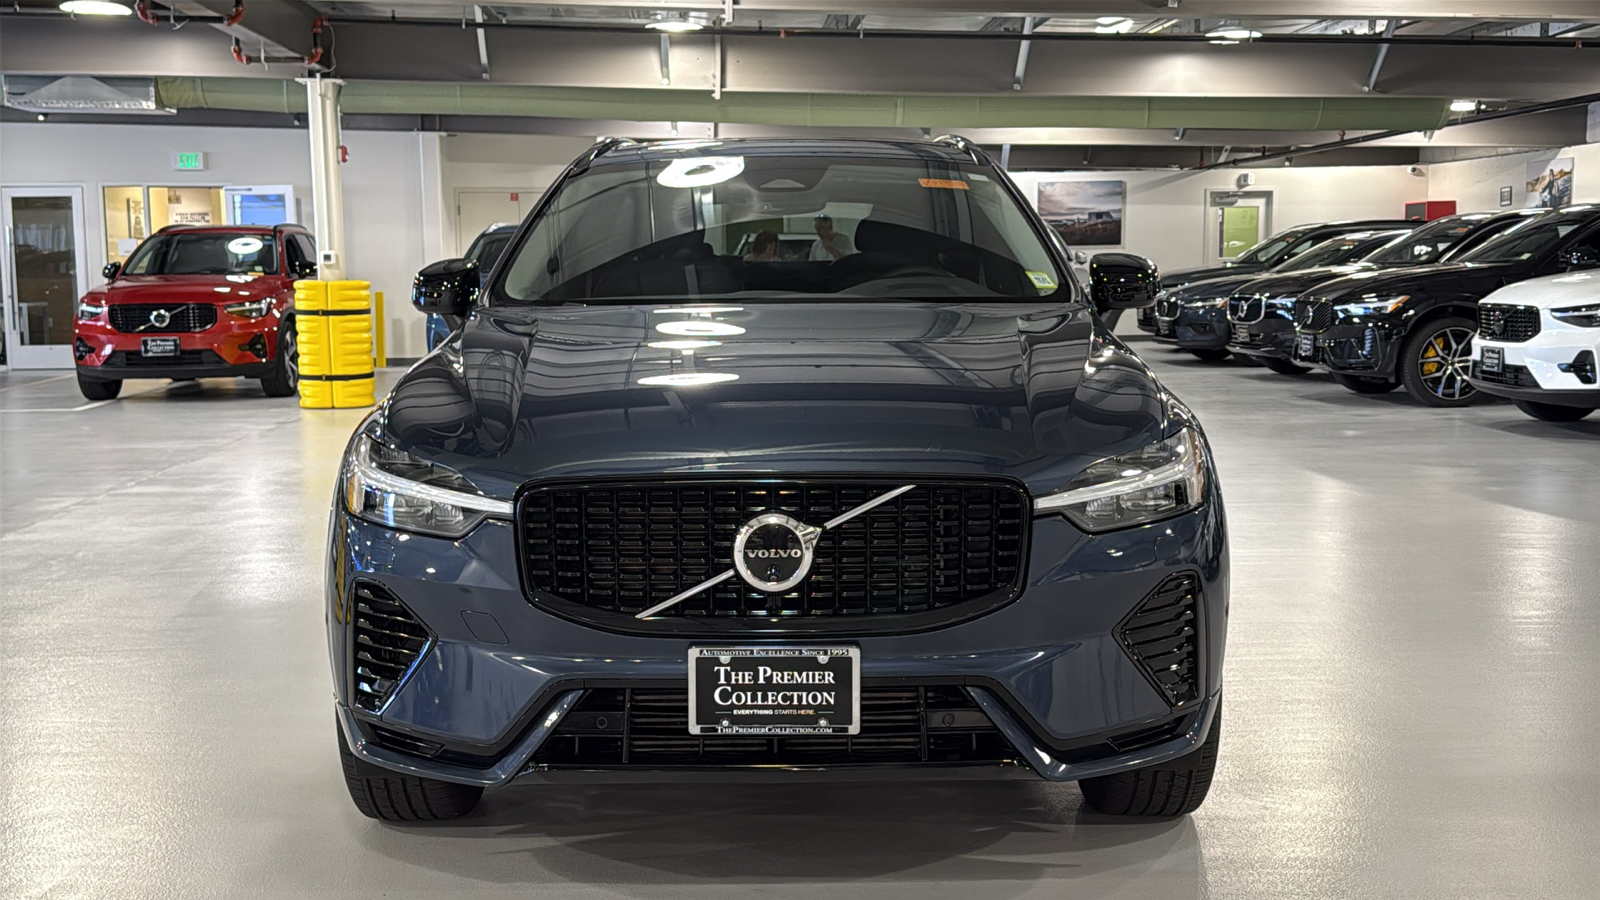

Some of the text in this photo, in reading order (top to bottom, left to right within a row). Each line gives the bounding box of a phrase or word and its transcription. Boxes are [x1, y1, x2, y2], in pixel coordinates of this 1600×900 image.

[179, 152, 199, 168] EXIT
[745, 549, 802, 558] VOLVO
[714, 666, 836, 684] THE PREMIER
[713, 686, 836, 706] COLLECTION
